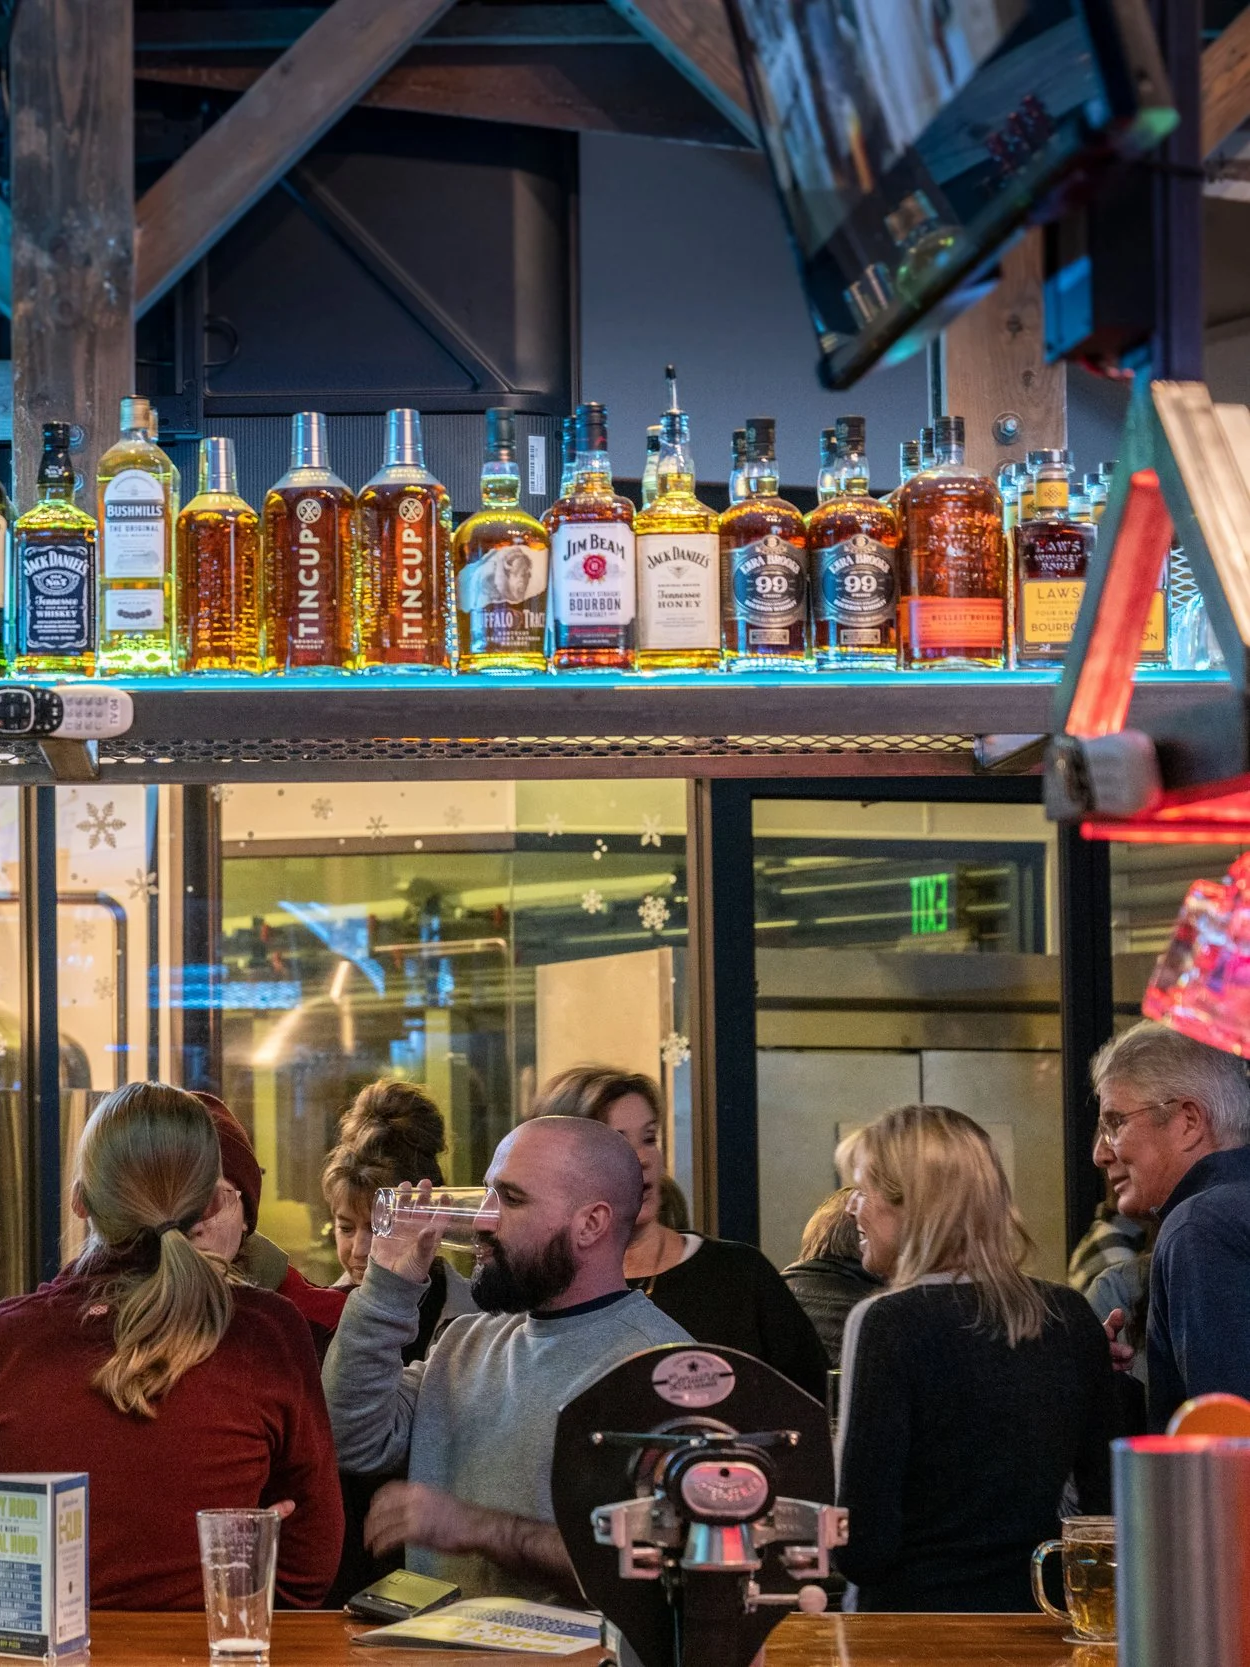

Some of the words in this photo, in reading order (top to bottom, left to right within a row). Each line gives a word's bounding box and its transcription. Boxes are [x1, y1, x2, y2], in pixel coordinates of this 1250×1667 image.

[106, 505, 163, 517] BUSHMILLS
[563, 538, 588, 561] JIM
[590, 533, 626, 560] BEAM
[23, 555, 50, 577] JACK
[48, 551, 89, 577] DANIEL'S
[647, 551, 672, 570] JACK
[672, 546, 711, 569] DANIEL'S
[298, 529, 321, 637] TINCUP
[402, 529, 423, 637] TINCUP
[755, 576, 788, 594] 99
[844, 575, 878, 593] 99
[657, 590, 701, 599] Tennessee
[1037, 587, 1080, 600] LAWS
[569, 598, 621, 611] BOURBON
[658, 601, 701, 609] HONEY
[484, 611, 514, 628] FFALO
[1031, 623, 1077, 632] BOURBO
[110, 709, 118, 724] TV
[8, 1496, 38, 1520] HOUR
[9, 1534, 38, 1556] HOUR
